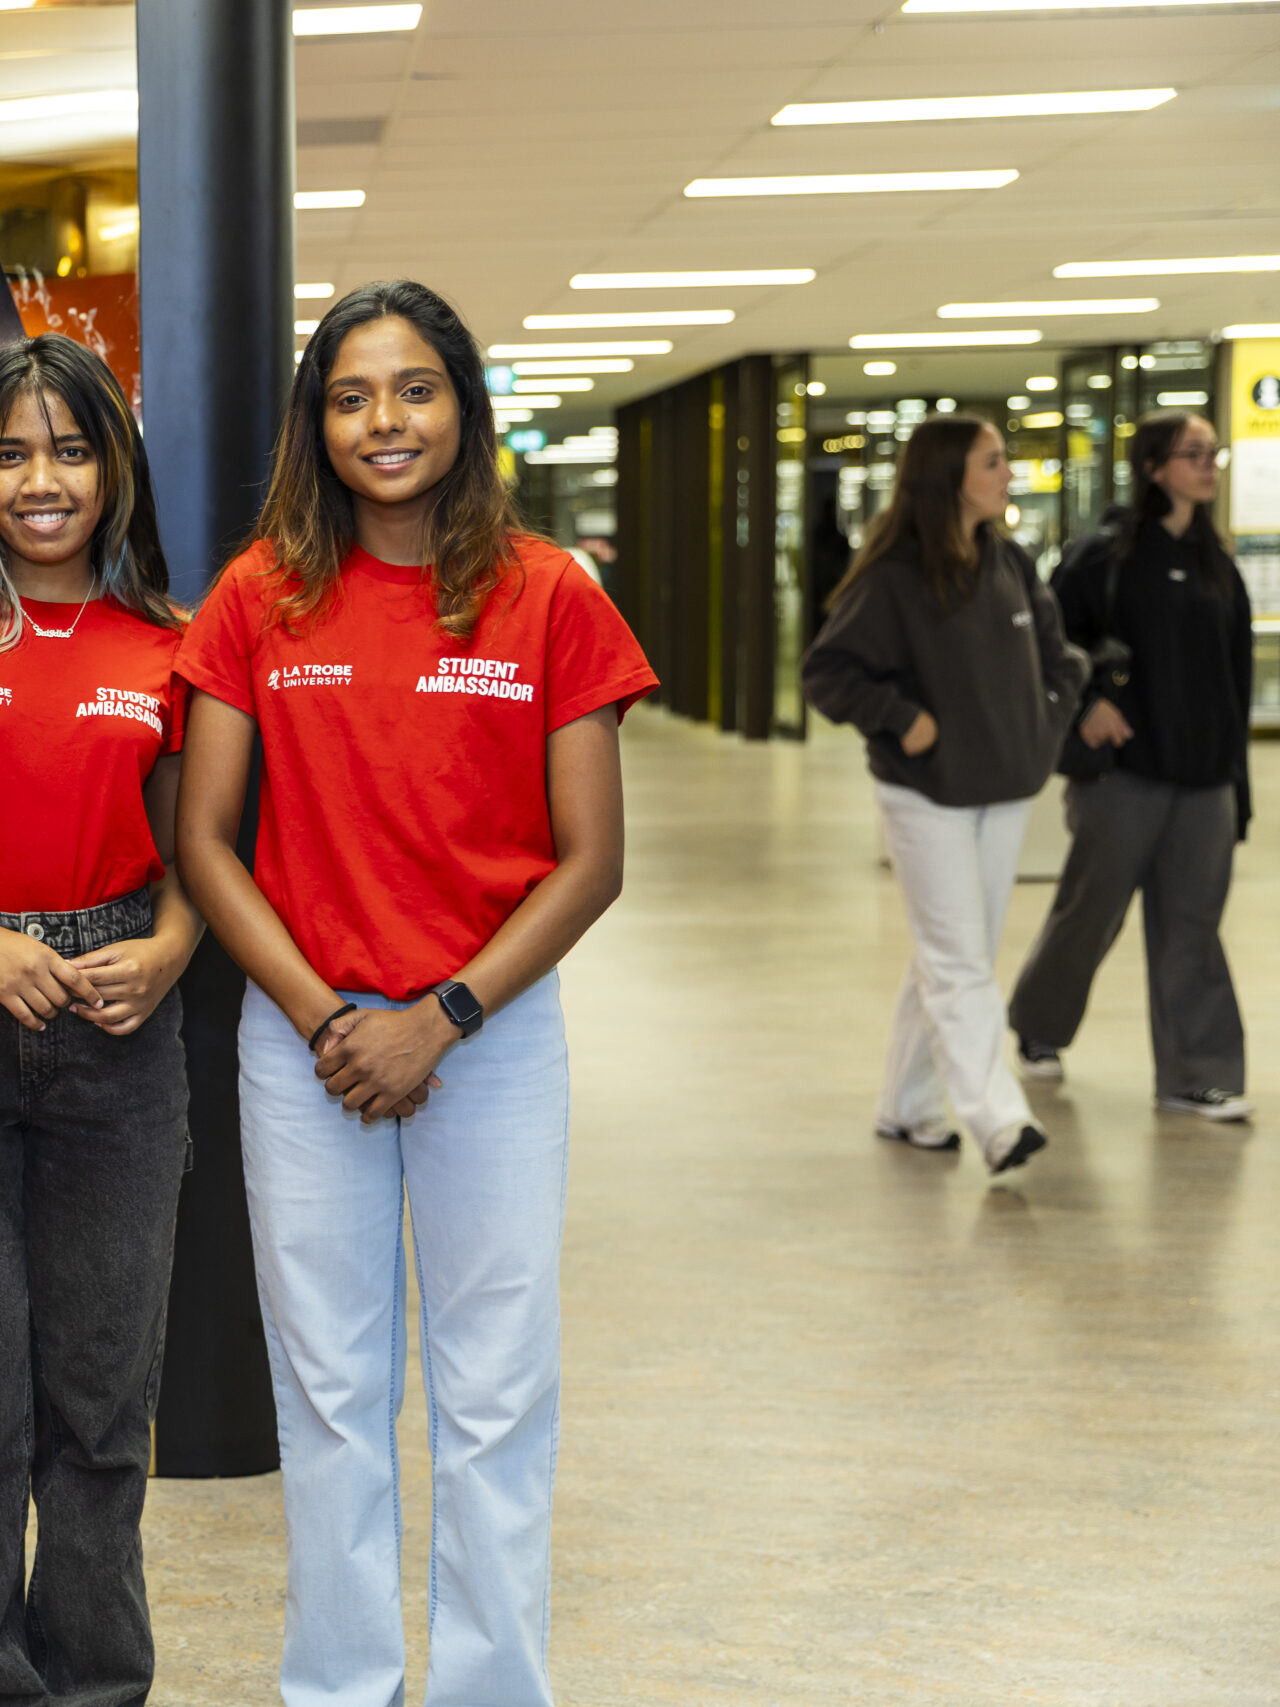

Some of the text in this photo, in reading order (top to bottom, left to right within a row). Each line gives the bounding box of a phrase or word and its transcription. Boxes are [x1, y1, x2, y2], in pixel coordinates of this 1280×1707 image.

[283, 664, 353, 678] LA TROBE
[437, 657, 519, 680] STUDENT
[283, 677, 352, 688] UNIVERSITY
[416, 676, 533, 702] AMBASSADOR
[96, 687, 160, 714] STUDENT
[75, 701, 163, 738] AMBASSADO
